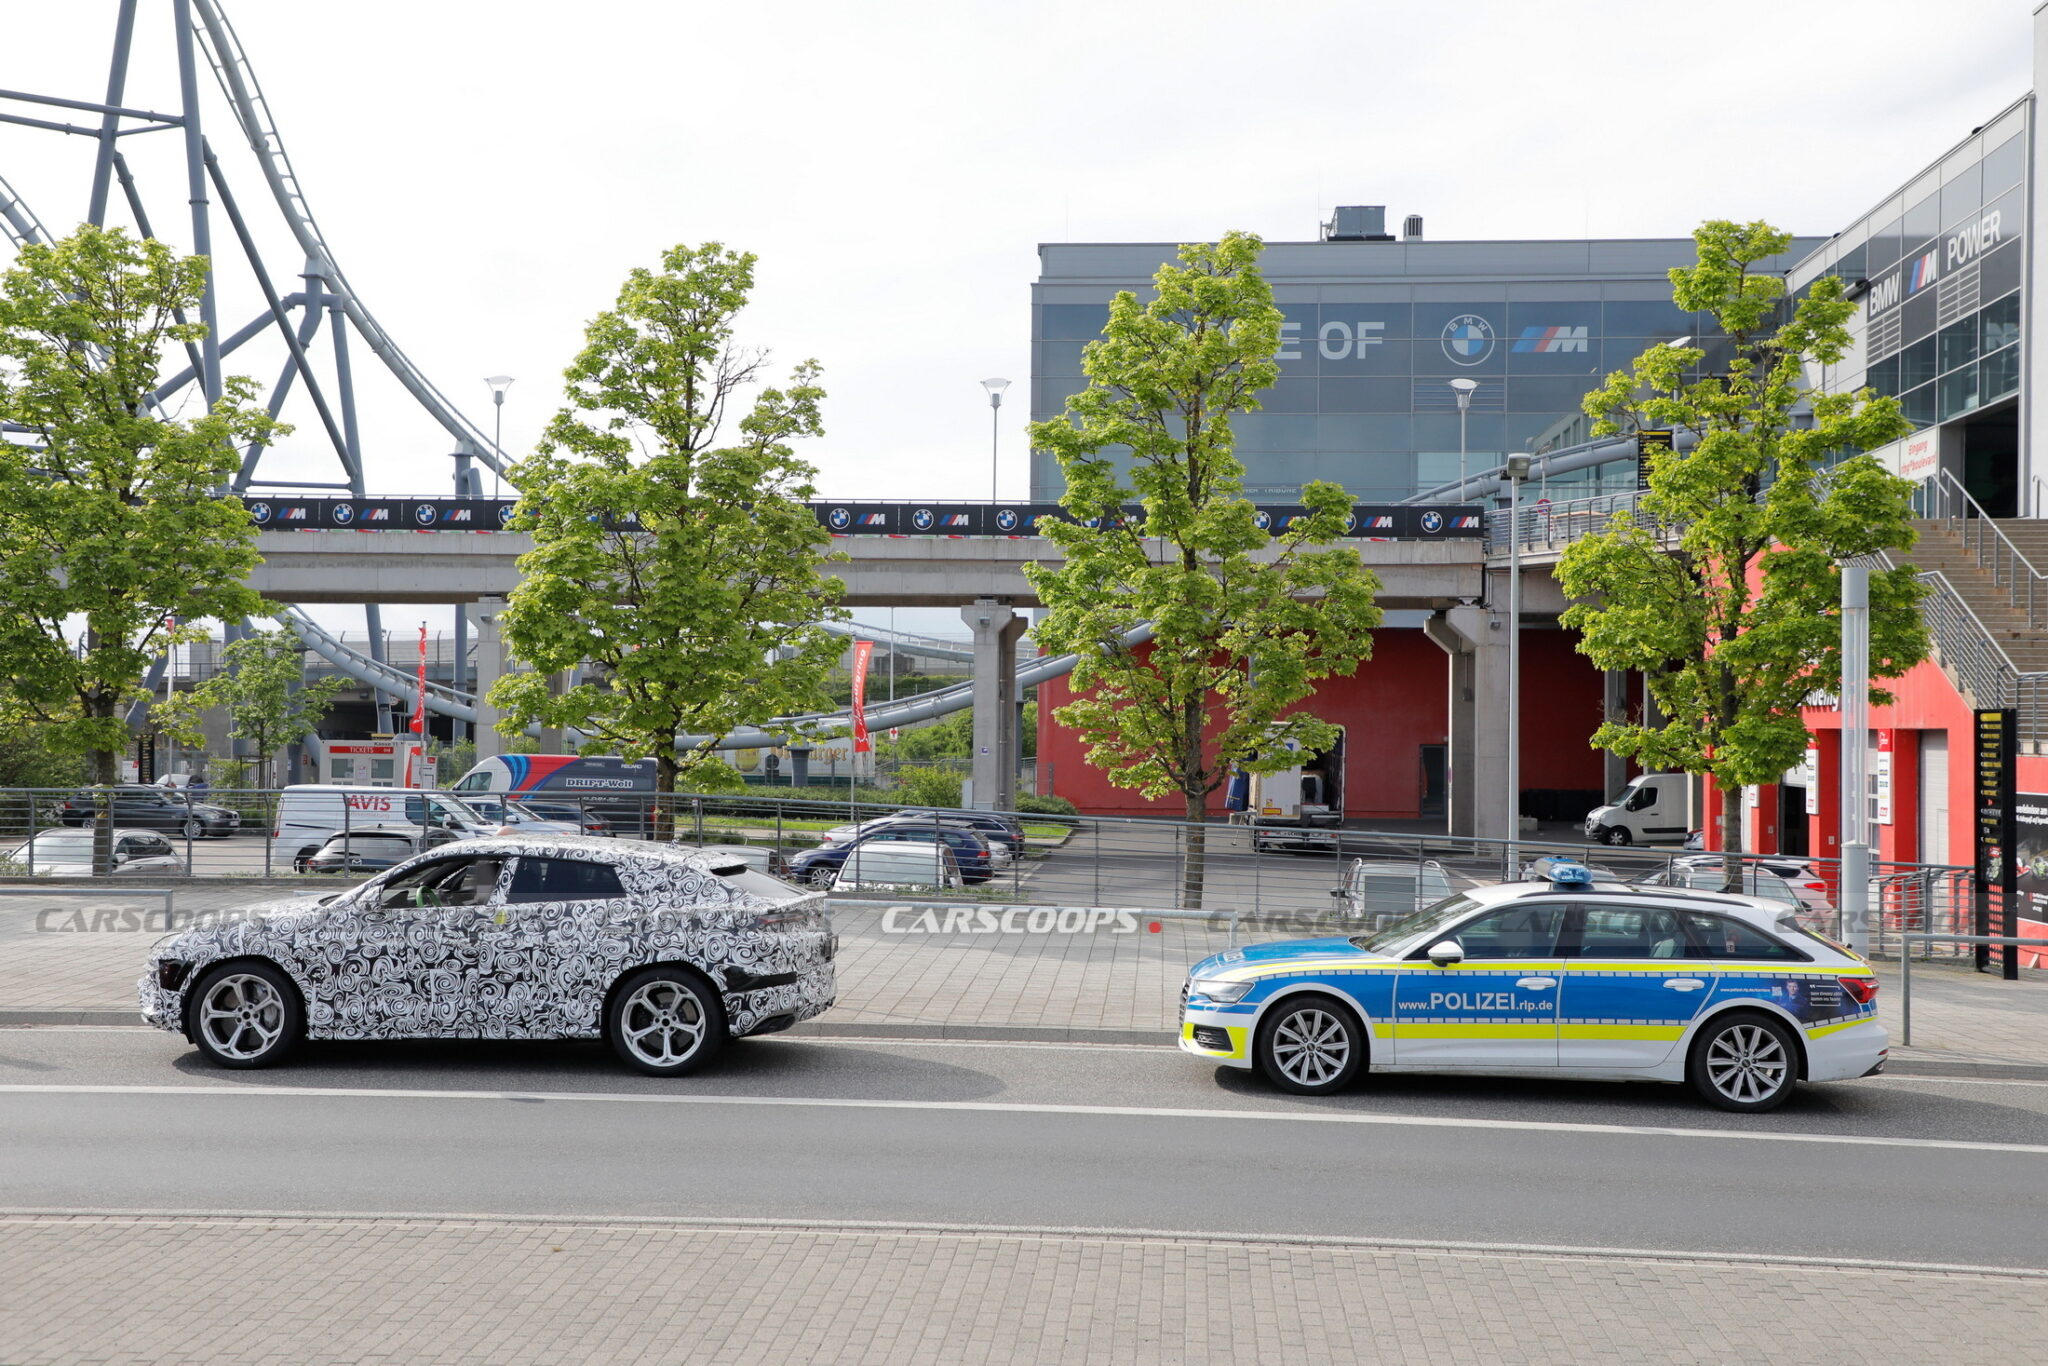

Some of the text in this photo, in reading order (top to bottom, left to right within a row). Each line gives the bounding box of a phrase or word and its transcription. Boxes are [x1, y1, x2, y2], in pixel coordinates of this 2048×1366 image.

[1870, 271, 1900, 317] BMW
[1947, 210, 2001, 271] POWER
[1449, 317, 1488, 332] BMW
[1318, 321, 1385, 360] OF
[348, 794, 391, 811] AVIS
[1398, 992, 1553, 1012] www.POLIZEI.rlp.de
